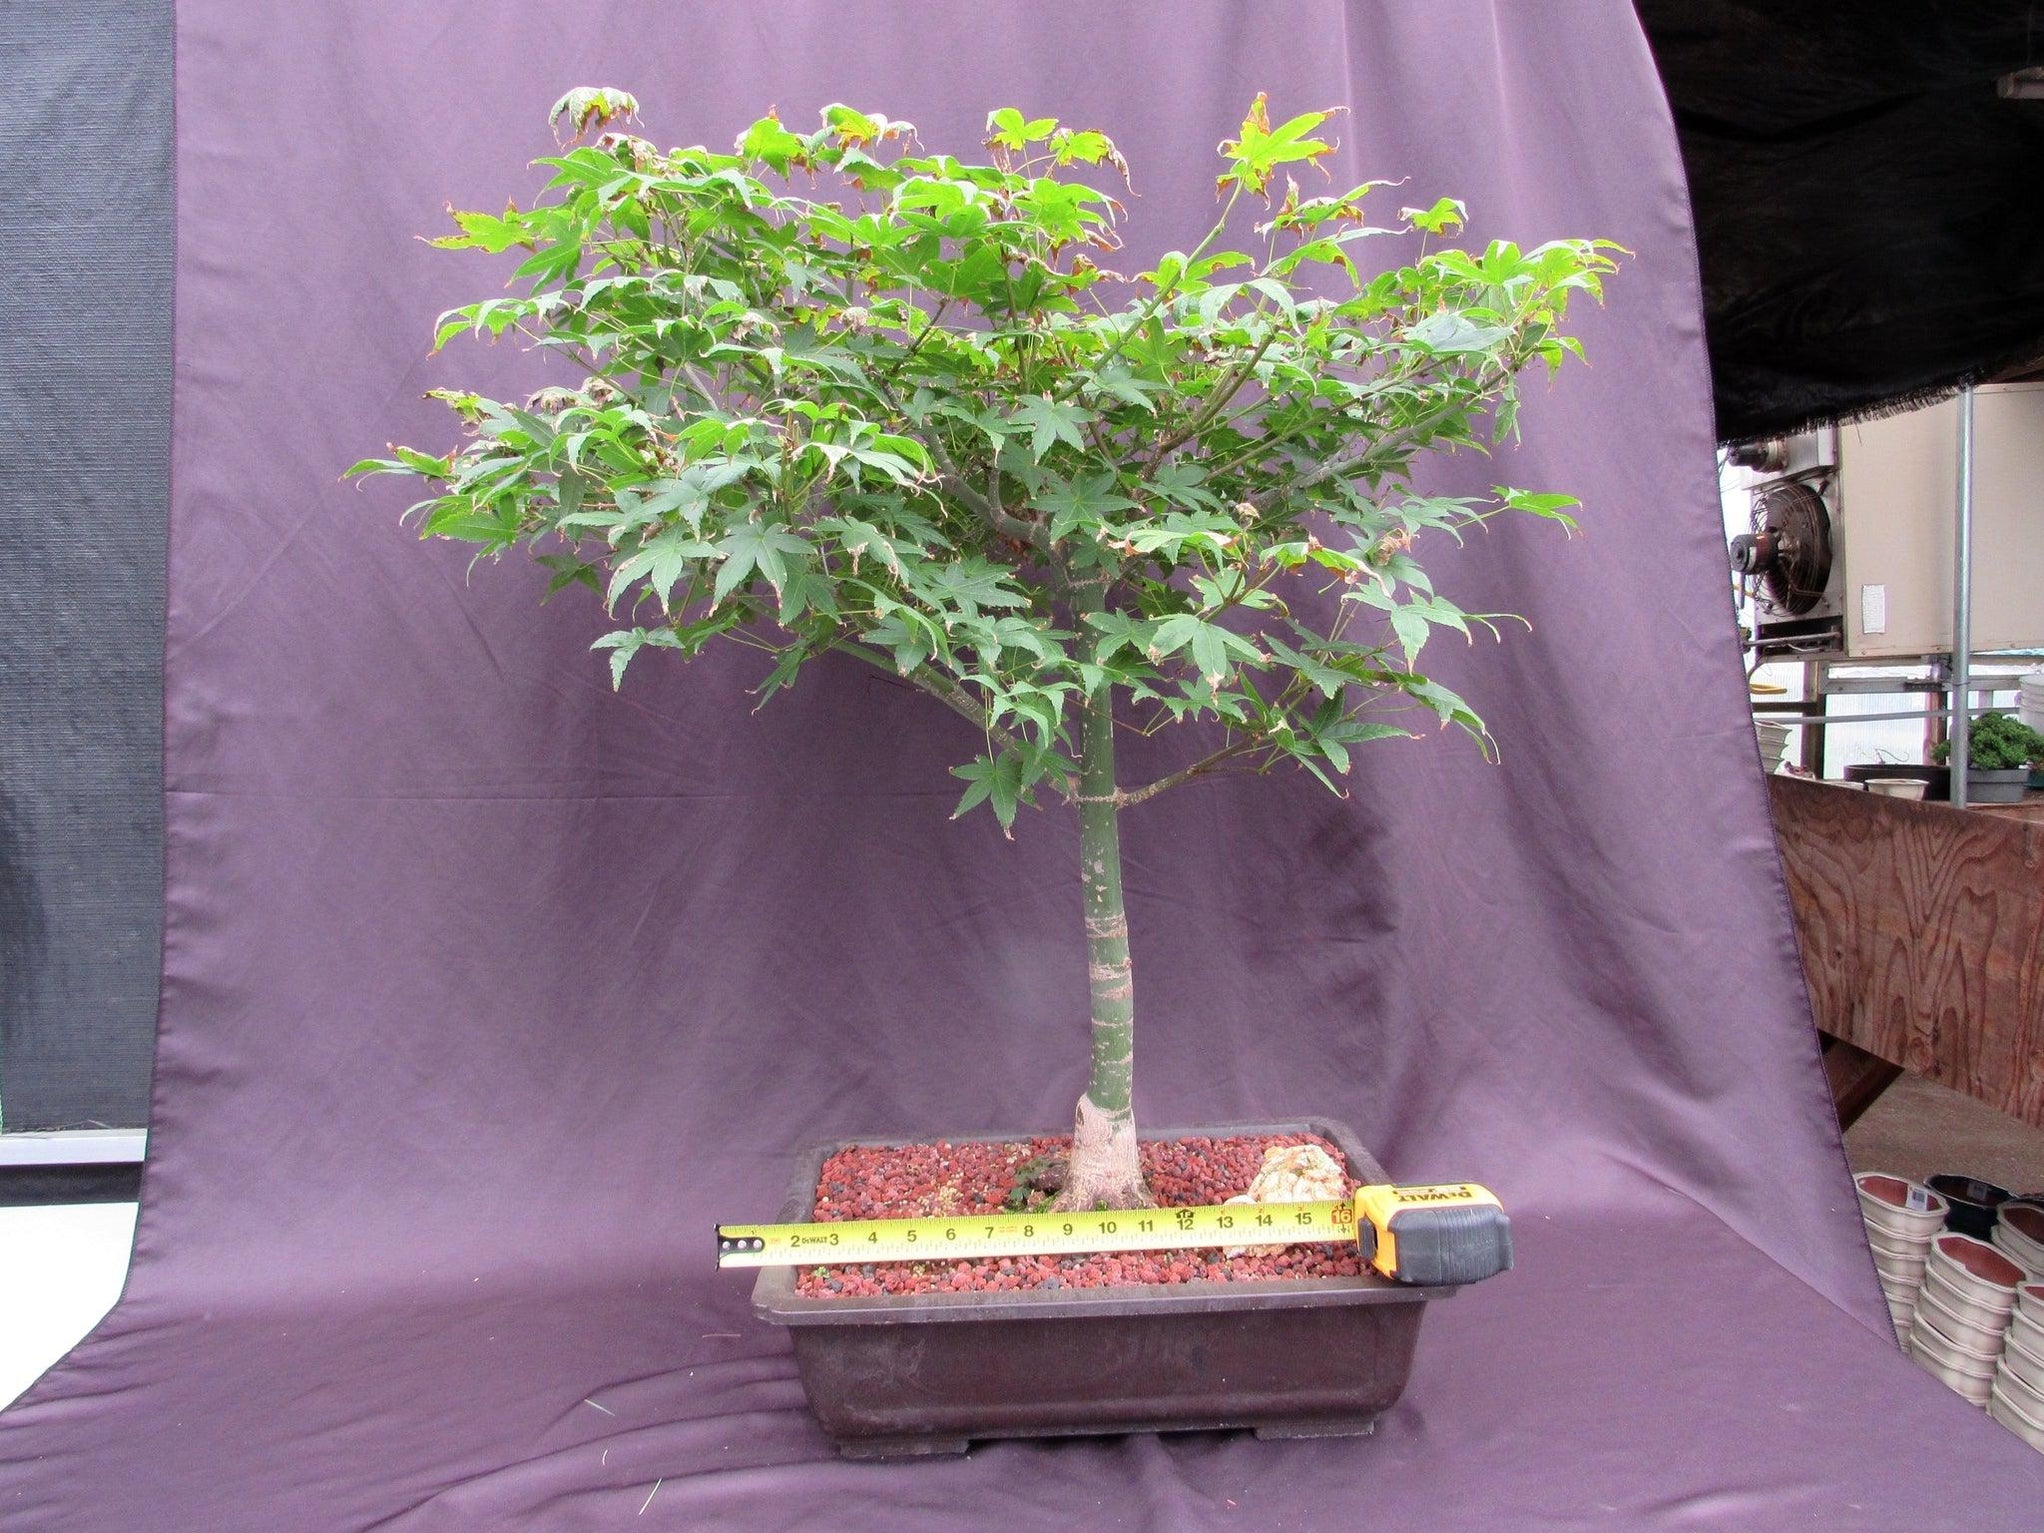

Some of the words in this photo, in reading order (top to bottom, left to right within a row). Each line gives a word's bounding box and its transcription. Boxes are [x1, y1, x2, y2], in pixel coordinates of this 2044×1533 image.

[790, 1235, 801, 1248] 2
[829, 1233, 839, 1246] 3
[868, 1231, 878, 1244] 4
[906, 1229, 917, 1242] 5
[946, 1228, 956, 1241] 6
[985, 1226, 994, 1239] 7
[1024, 1224, 1034, 1237] 8
[1063, 1223, 1073, 1236] 9
[1098, 1221, 1117, 1234] 10
[1138, 1219, 1154, 1232] 11
[1176, 1218, 1194, 1231] 12
[1216, 1216, 1234, 1229] 13
[1255, 1214, 1273, 1226] 14
[1295, 1212, 1312, 1225] 15
[1331, 1209, 1353, 1224] 16
